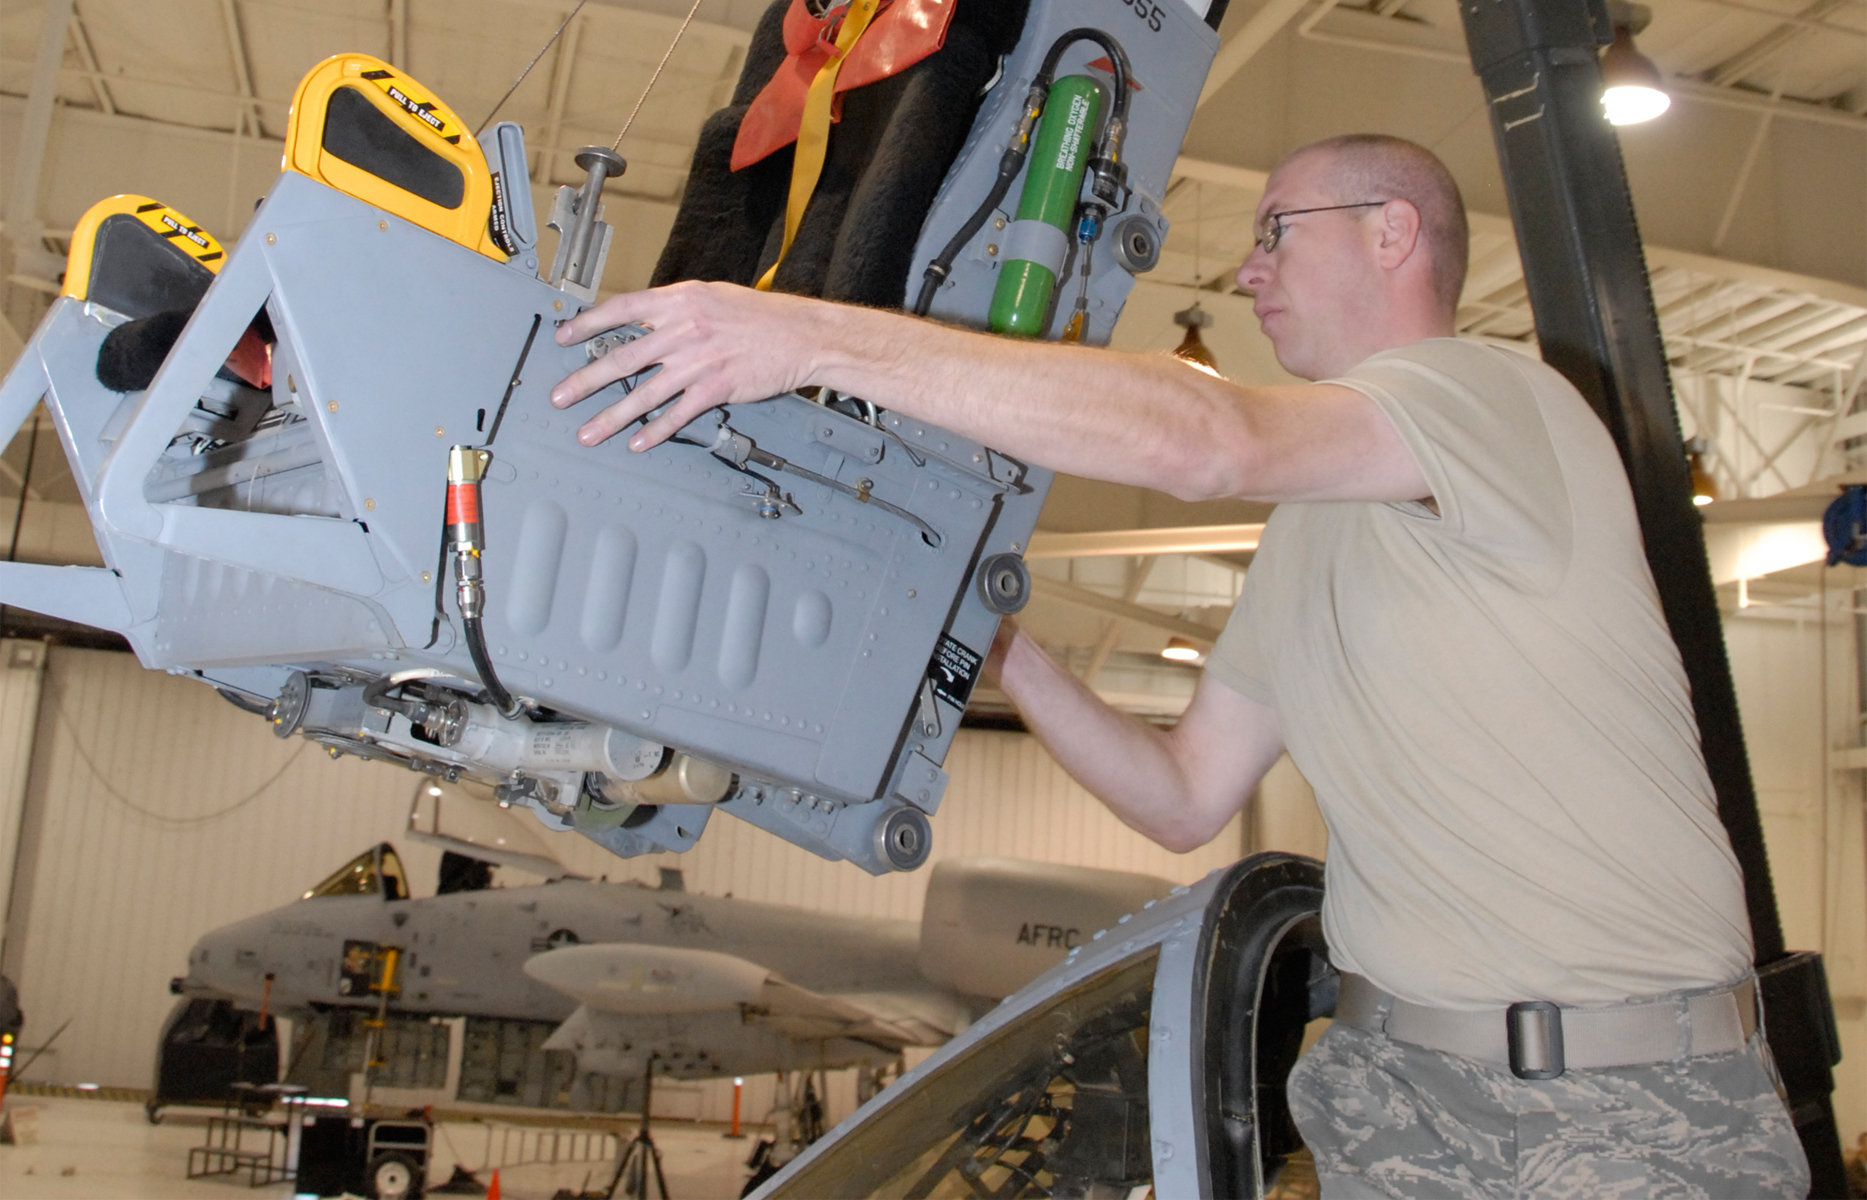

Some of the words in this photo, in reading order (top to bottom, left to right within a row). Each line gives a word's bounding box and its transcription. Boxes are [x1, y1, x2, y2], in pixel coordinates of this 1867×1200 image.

[390, 88, 407, 105] PULL
[408, 100, 418, 112] TO
[418, 108, 441, 127] EJECT
[1056, 127, 1074, 169] BREATHING
[1067, 94, 1082, 125] OXYGEN
[1065, 99, 1090, 172] NON-SHATTERABLE
[163, 216, 178, 230] PULL
[179, 225, 188, 235] TO
[187, 231, 207, 246] EJECT
[494, 177, 503, 213] EJECTION
[499, 214, 515, 253] CONTROLS
[957, 647, 977, 665] CRANK
[959, 659, 971, 670] PIN
[1017, 922, 1080, 950] AFRC
